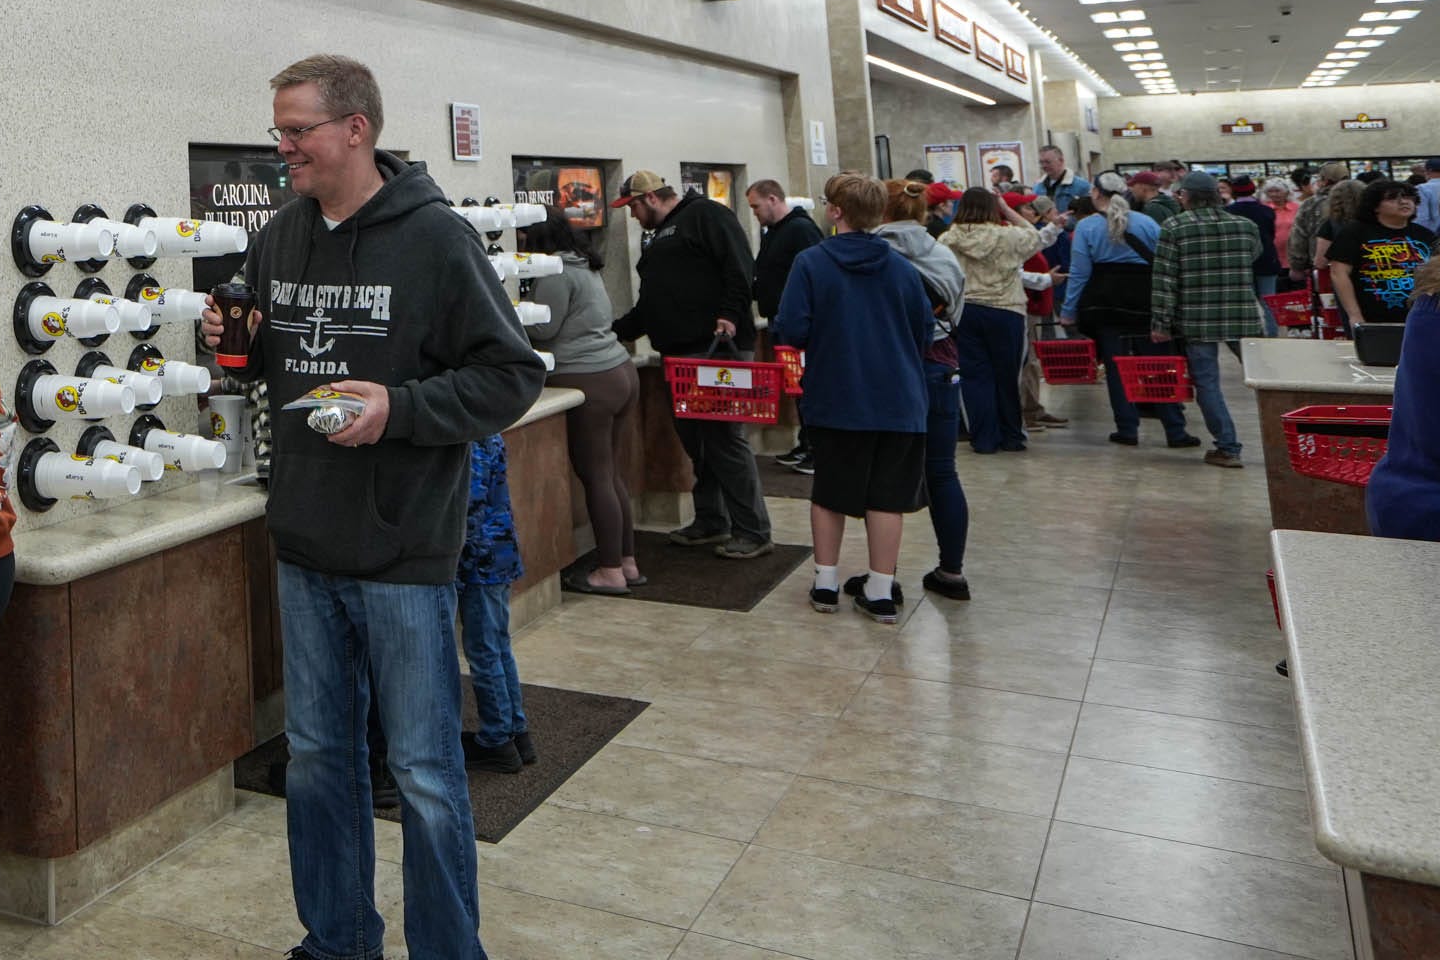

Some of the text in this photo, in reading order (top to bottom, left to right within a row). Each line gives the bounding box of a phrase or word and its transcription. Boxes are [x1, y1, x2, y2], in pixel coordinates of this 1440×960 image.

[212, 183, 271, 206] CAROLINA
[271, 279, 314, 312] PANMA
[316, 285, 343, 308] CITY
[285, 358, 350, 375] FLORIDA
